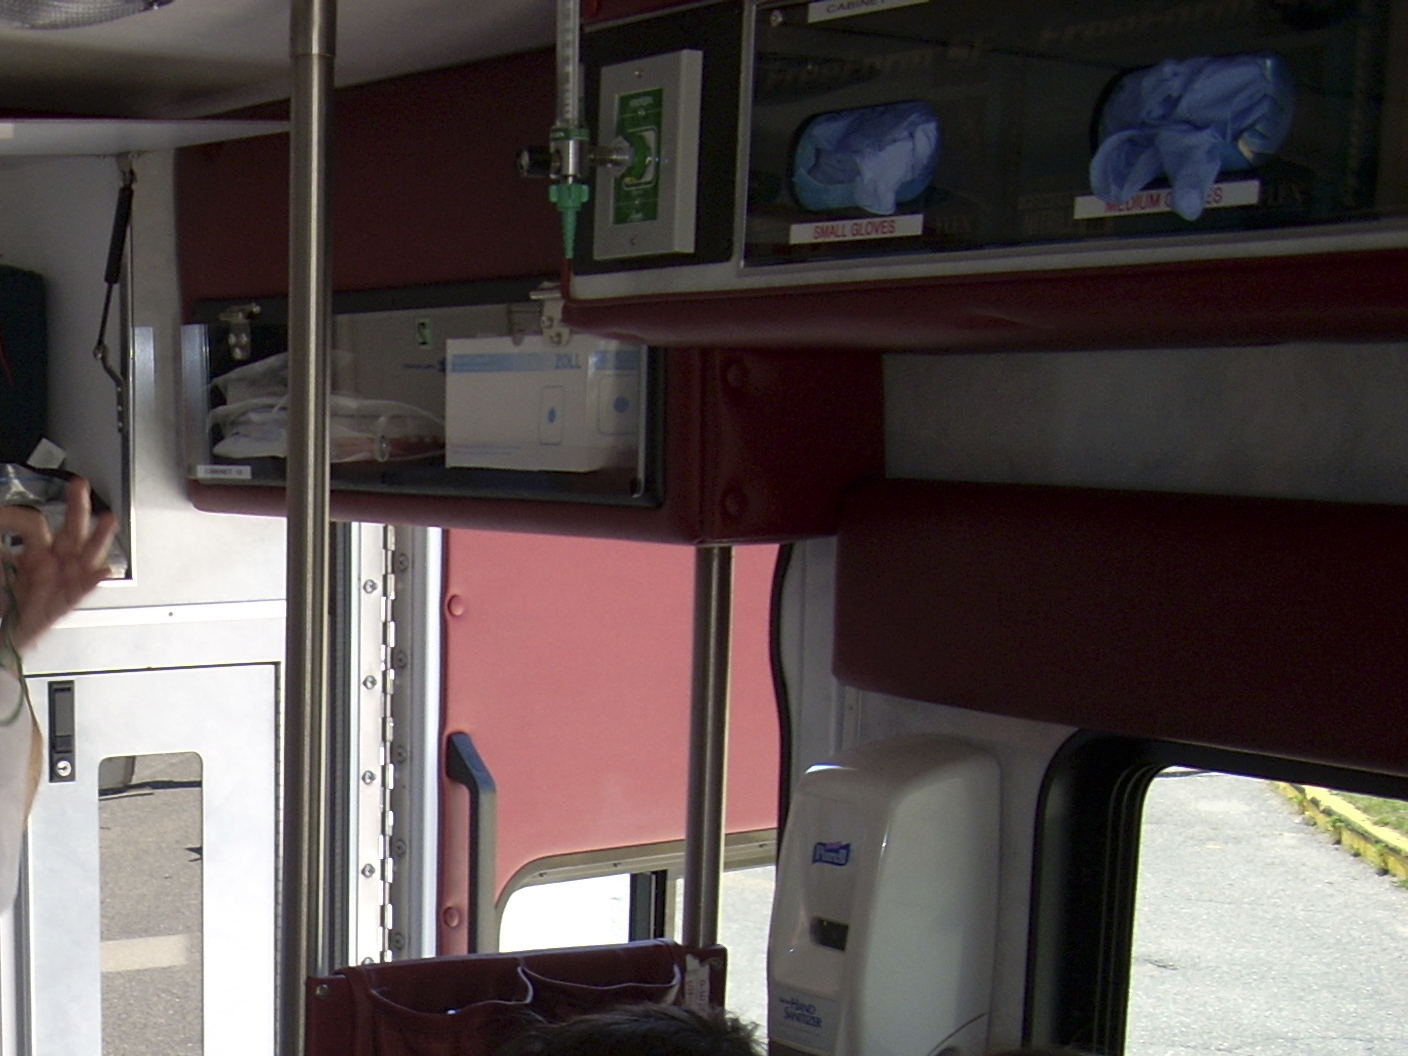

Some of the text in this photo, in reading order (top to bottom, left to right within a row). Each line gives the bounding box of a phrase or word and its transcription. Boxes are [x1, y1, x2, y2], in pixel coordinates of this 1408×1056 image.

[826, 0, 885, 13] CABINE
[814, 220, 896, 239] SMALL GLOVES
